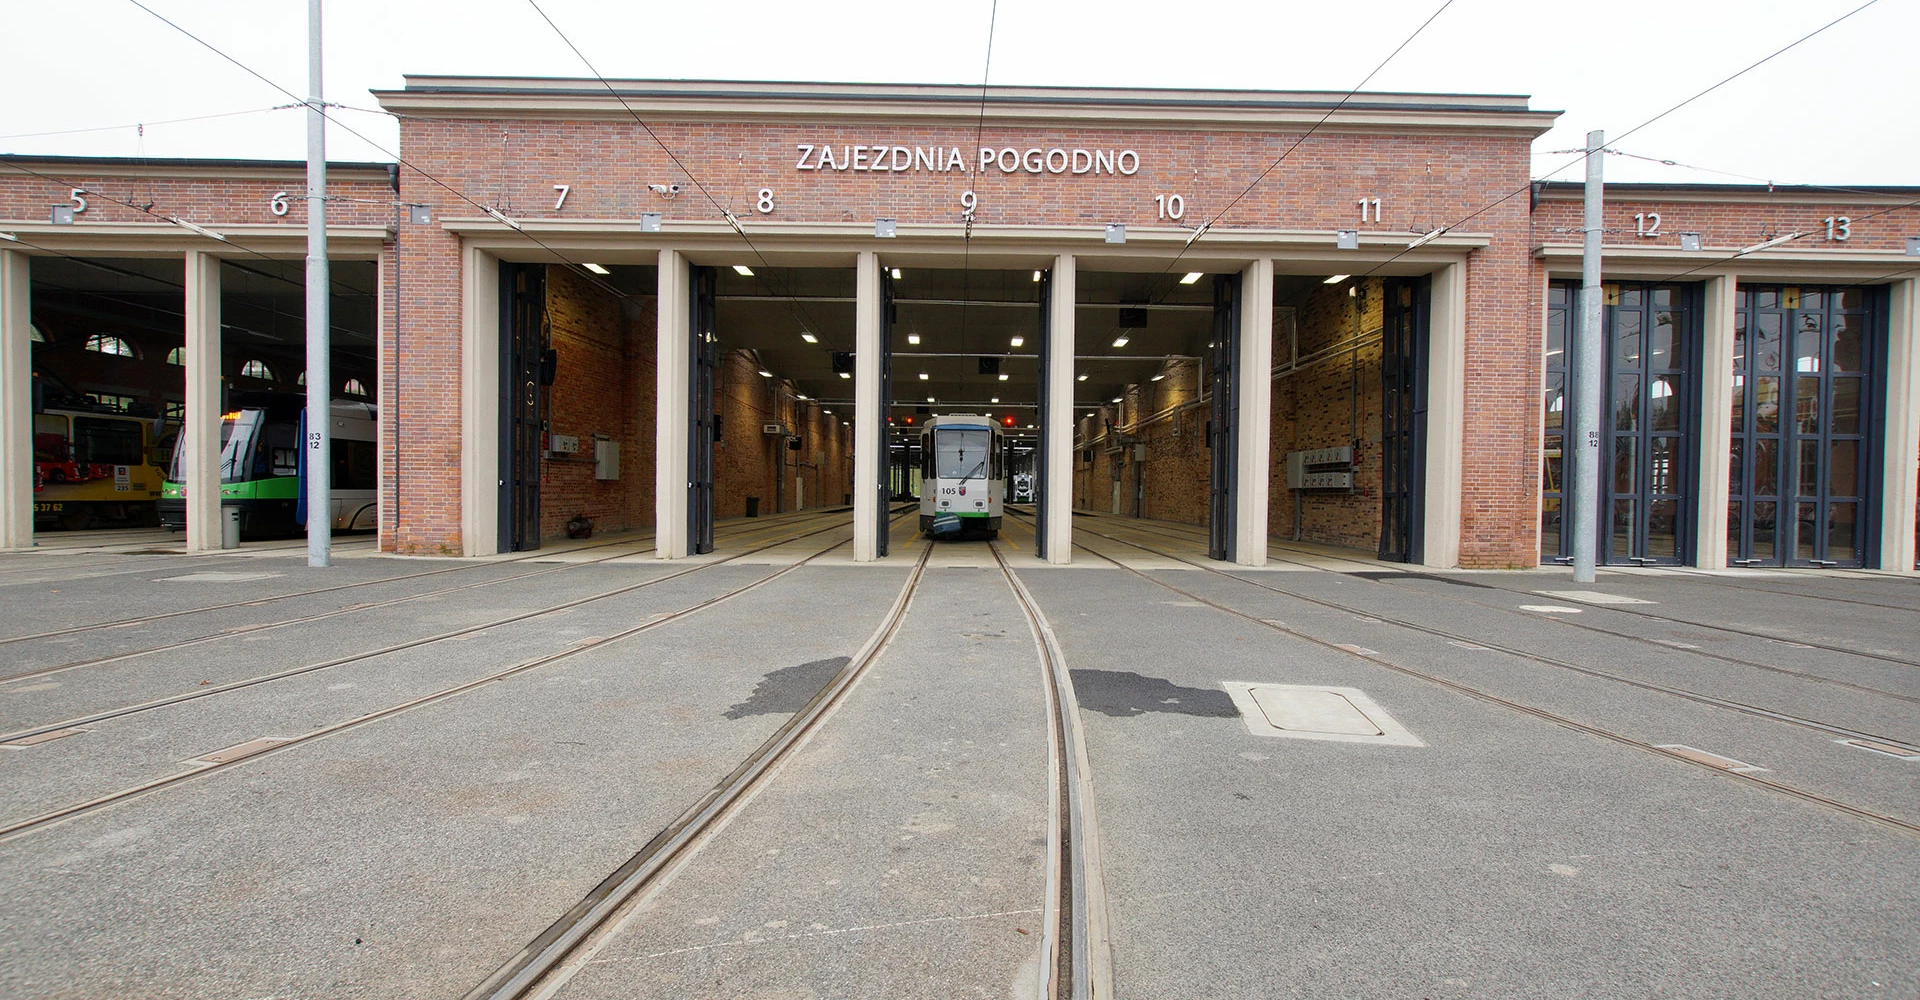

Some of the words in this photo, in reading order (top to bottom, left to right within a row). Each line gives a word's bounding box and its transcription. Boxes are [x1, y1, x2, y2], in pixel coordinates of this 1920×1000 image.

[796, 145, 966, 171] ZAJEZDNIA
[980, 147, 1140, 176] POGODNO
[71, 188, 87, 213] 5
[271, 191, 289, 216] 6
[553, 184, 570, 210] 7
[757, 188, 775, 214] 8
[960, 190, 977, 214] 9
[1155, 194, 1184, 220] 10
[1358, 197, 1381, 222] 11
[1634, 212, 1660, 237] 12
[1823, 216, 1851, 240] 13
[309, 432, 321, 440] 83
[310, 441, 319, 449] 12
[1590, 439, 1598, 447] 12
[40, 503, 51, 511] 37
